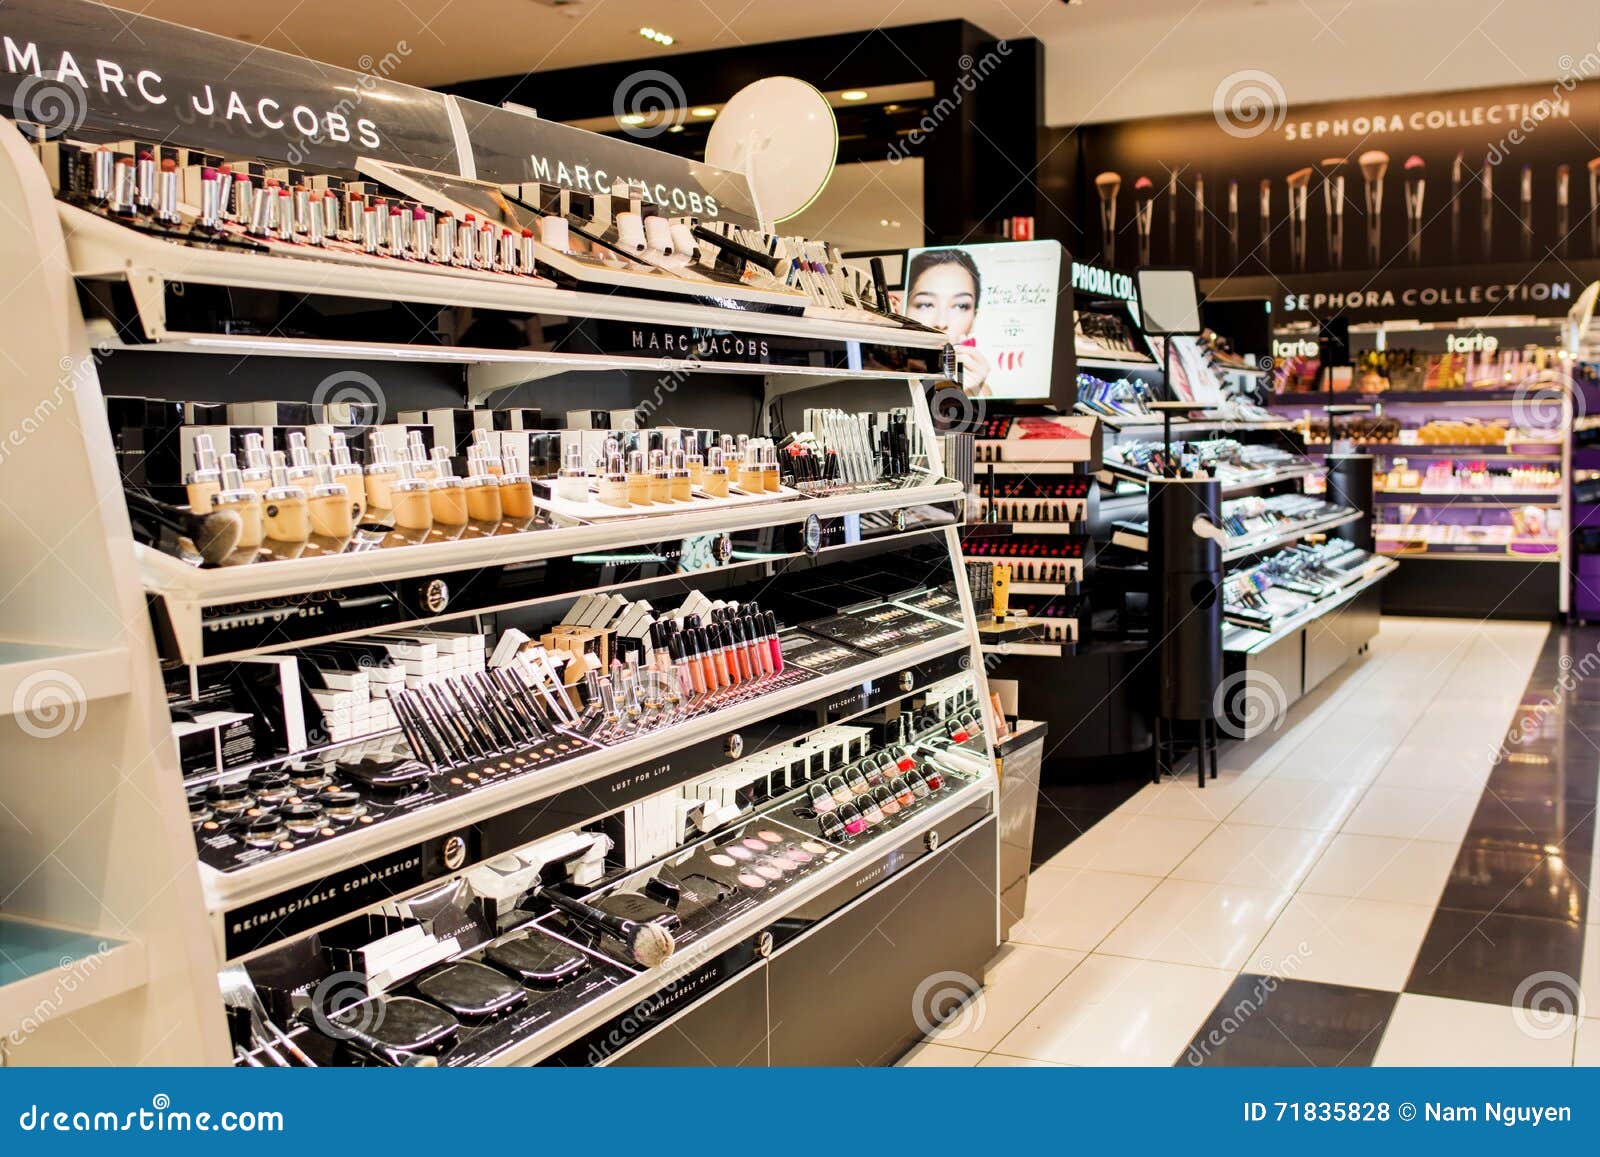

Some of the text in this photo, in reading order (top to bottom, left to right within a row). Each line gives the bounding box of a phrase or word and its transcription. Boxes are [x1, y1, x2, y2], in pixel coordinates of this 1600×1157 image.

[3, 36, 380, 149] MARC JACOBS
[1285, 101, 1570, 141] SEPHORA COLLECTION
[530, 154, 718, 217] MARC ACOBS
[1284, 282, 1571, 311] SEPHORA COLLECTION
[632, 330, 689, 351] MARC
[697, 334, 768, 356] JACOBS
[611, 764, 671, 792] LUST FOR LIPS
[233, 856, 420, 935] RE(MARC)ABLE COMPLEXION
[700, 968, 717, 984] CHIC
